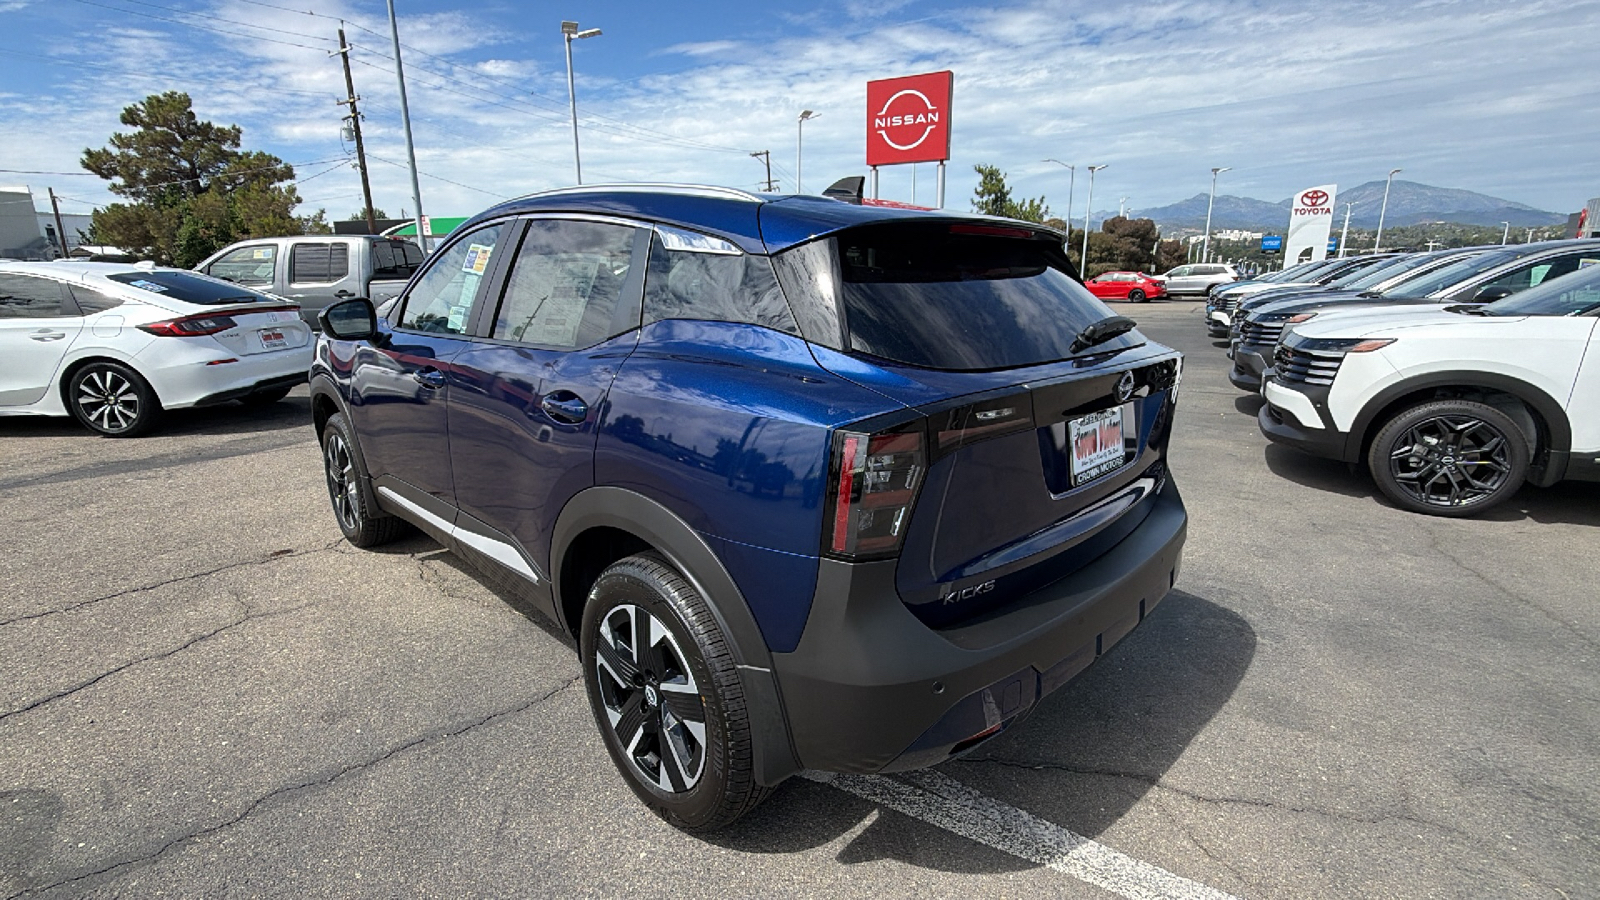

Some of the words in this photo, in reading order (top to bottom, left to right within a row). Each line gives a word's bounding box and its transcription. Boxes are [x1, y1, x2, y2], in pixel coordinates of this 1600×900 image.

[875, 112, 939, 128] NISSAN
[1294, 207, 1331, 216] TOYOTA
[1077, 466, 1100, 483] CROWN
[1100, 456, 1124, 477] MOTORS
[943, 580, 996, 605] KICKS
